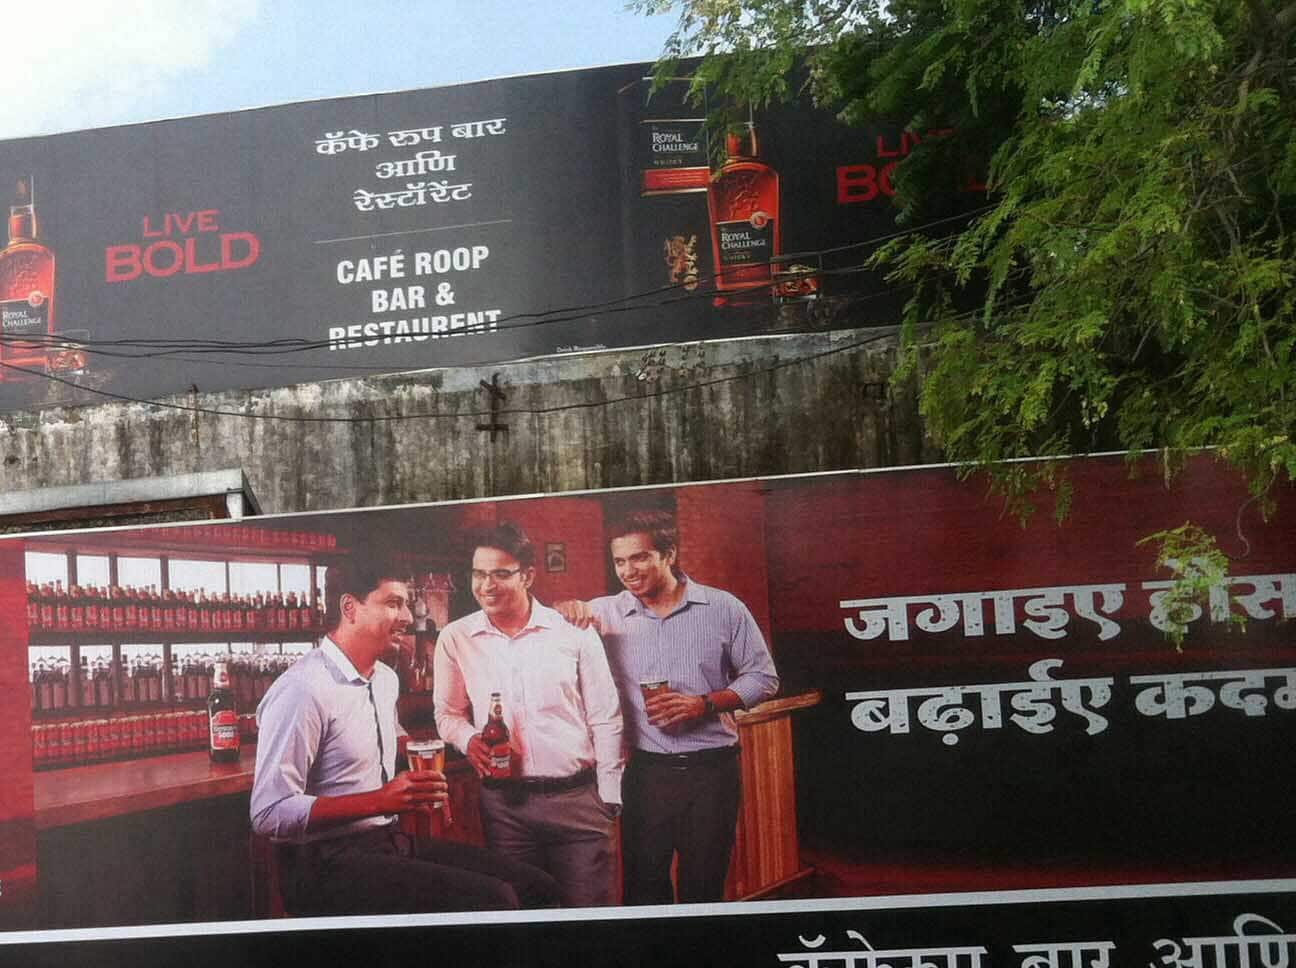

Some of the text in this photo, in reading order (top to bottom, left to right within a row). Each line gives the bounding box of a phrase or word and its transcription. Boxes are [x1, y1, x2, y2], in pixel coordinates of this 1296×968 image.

[315, 130, 380, 155] कॅफे
[451, 118, 507, 139] बार
[375, 150, 457, 179] आणि
[143, 208, 220, 238] LIVE
[105, 231, 260, 283] BOLD
[336, 245, 490, 285] CAFÉ ROOP
[371, 282, 456, 313] BAR &
[329, 309, 502, 351] RESTAURENT
[840, 555, 1296, 641] जगाइए हौस
